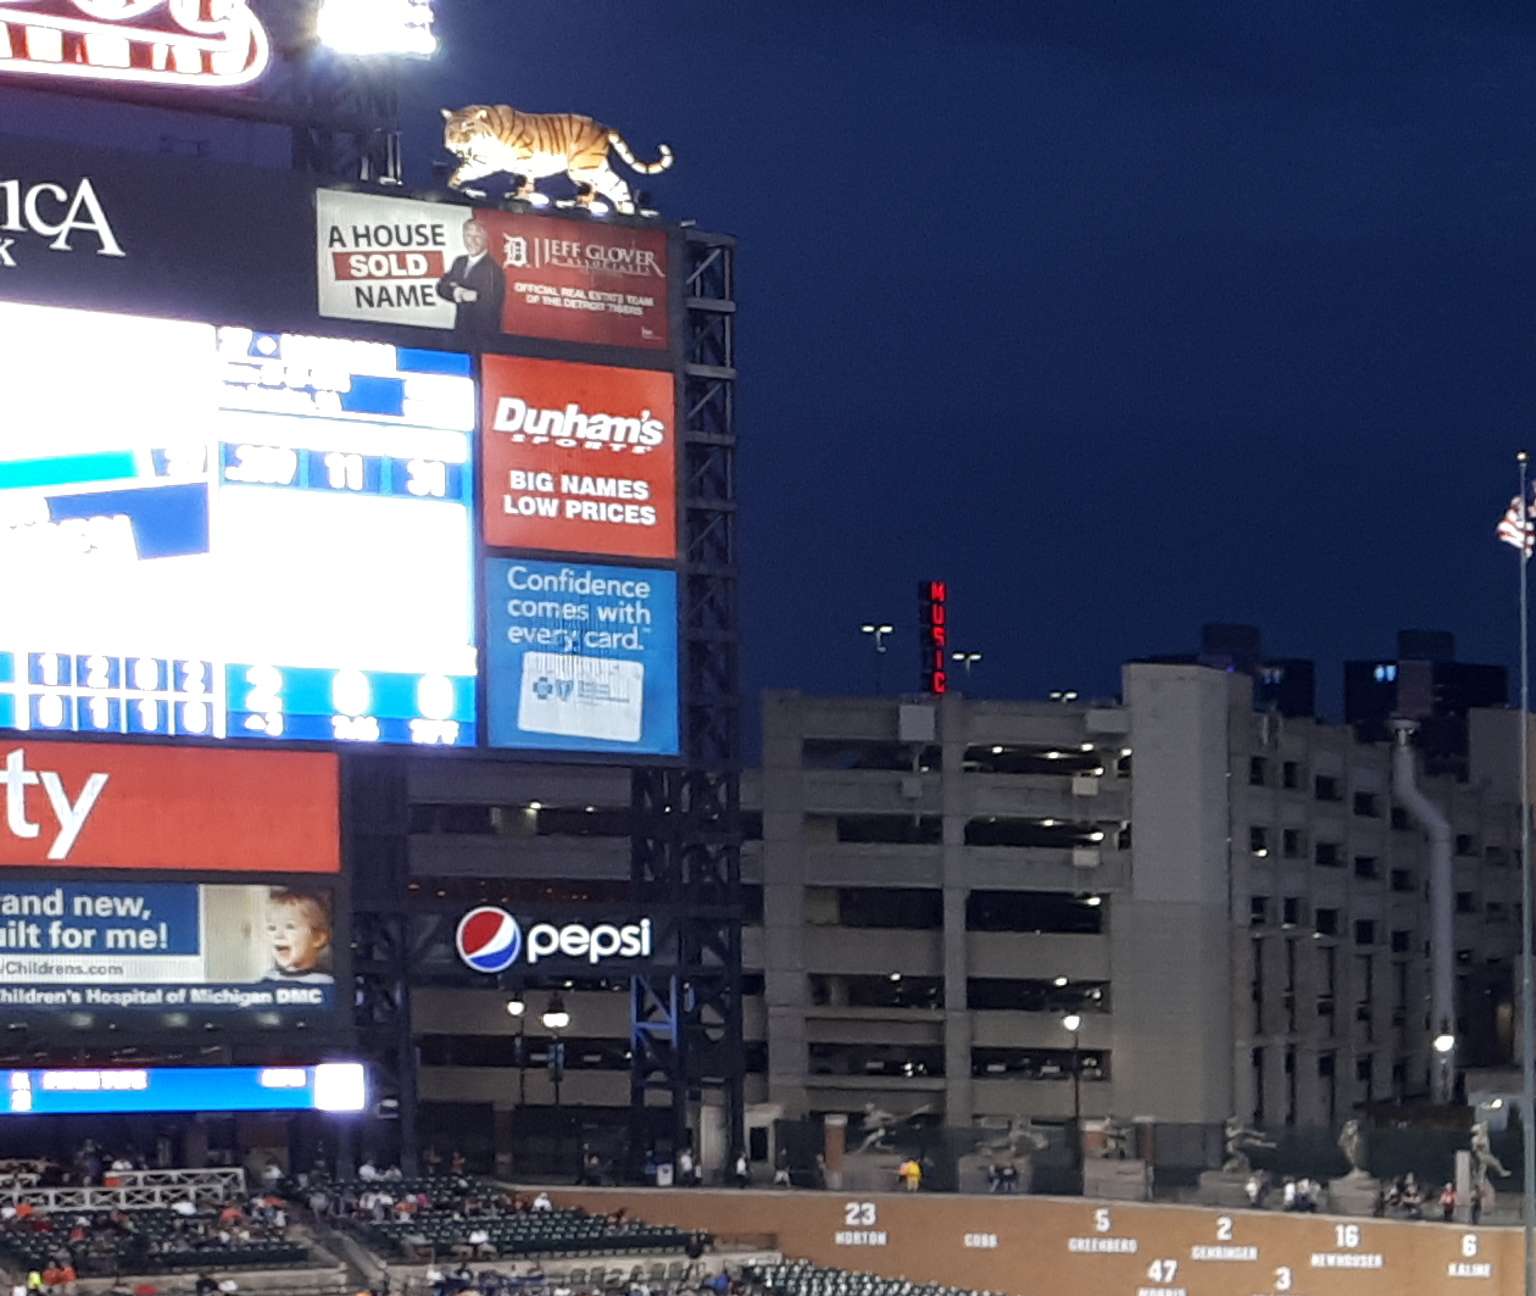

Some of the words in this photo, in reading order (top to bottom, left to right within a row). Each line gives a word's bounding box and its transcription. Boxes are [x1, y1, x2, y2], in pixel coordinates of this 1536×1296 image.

[328, 225, 346, 247] A
[354, 224, 446, 248] HOUSE
[349, 253, 428, 279] SOLD
[585, 244, 666, 277] GLOVER
[355, 284, 437, 309] NAME
[513, 281, 559, 297] OFFICIAL
[561, 286, 587, 300] REAL
[526, 294, 539, 304] OF
[493, 396, 664, 446] Dunham's
[510, 470, 554, 492] BIG
[560, 474, 650, 500] NAMES
[504, 494, 559, 518] LOW
[565, 500, 657, 526] PRICES
[507, 565, 651, 598] Confidence
[507, 599, 590, 621] comes
[597, 601, 652, 625] with
[507, 625, 577, 653] every
[931, 581, 946, 695] MUSIC
[0, 887, 64, 916] and
[73, 893, 151, 921] new,
[48, 920, 97, 949] for
[106, 923, 168, 950] me!
[527, 918, 650, 964] pepsi
[86, 989, 164, 1007] Hospital
[166, 989, 186, 1004] of
[190, 990, 273, 1008] Michigan
[276, 990, 323, 1005] DMC
[845, 1202, 876, 1226] 23
[1094, 1208, 1111, 1233] 5
[1216, 1215, 1233, 1240] 2
[1335, 1224, 1360, 1248] 16
[1461, 1234, 1478, 1257] 6
[1147, 1259, 1178, 1283] 47
[1274, 1266, 1292, 1291] 3
